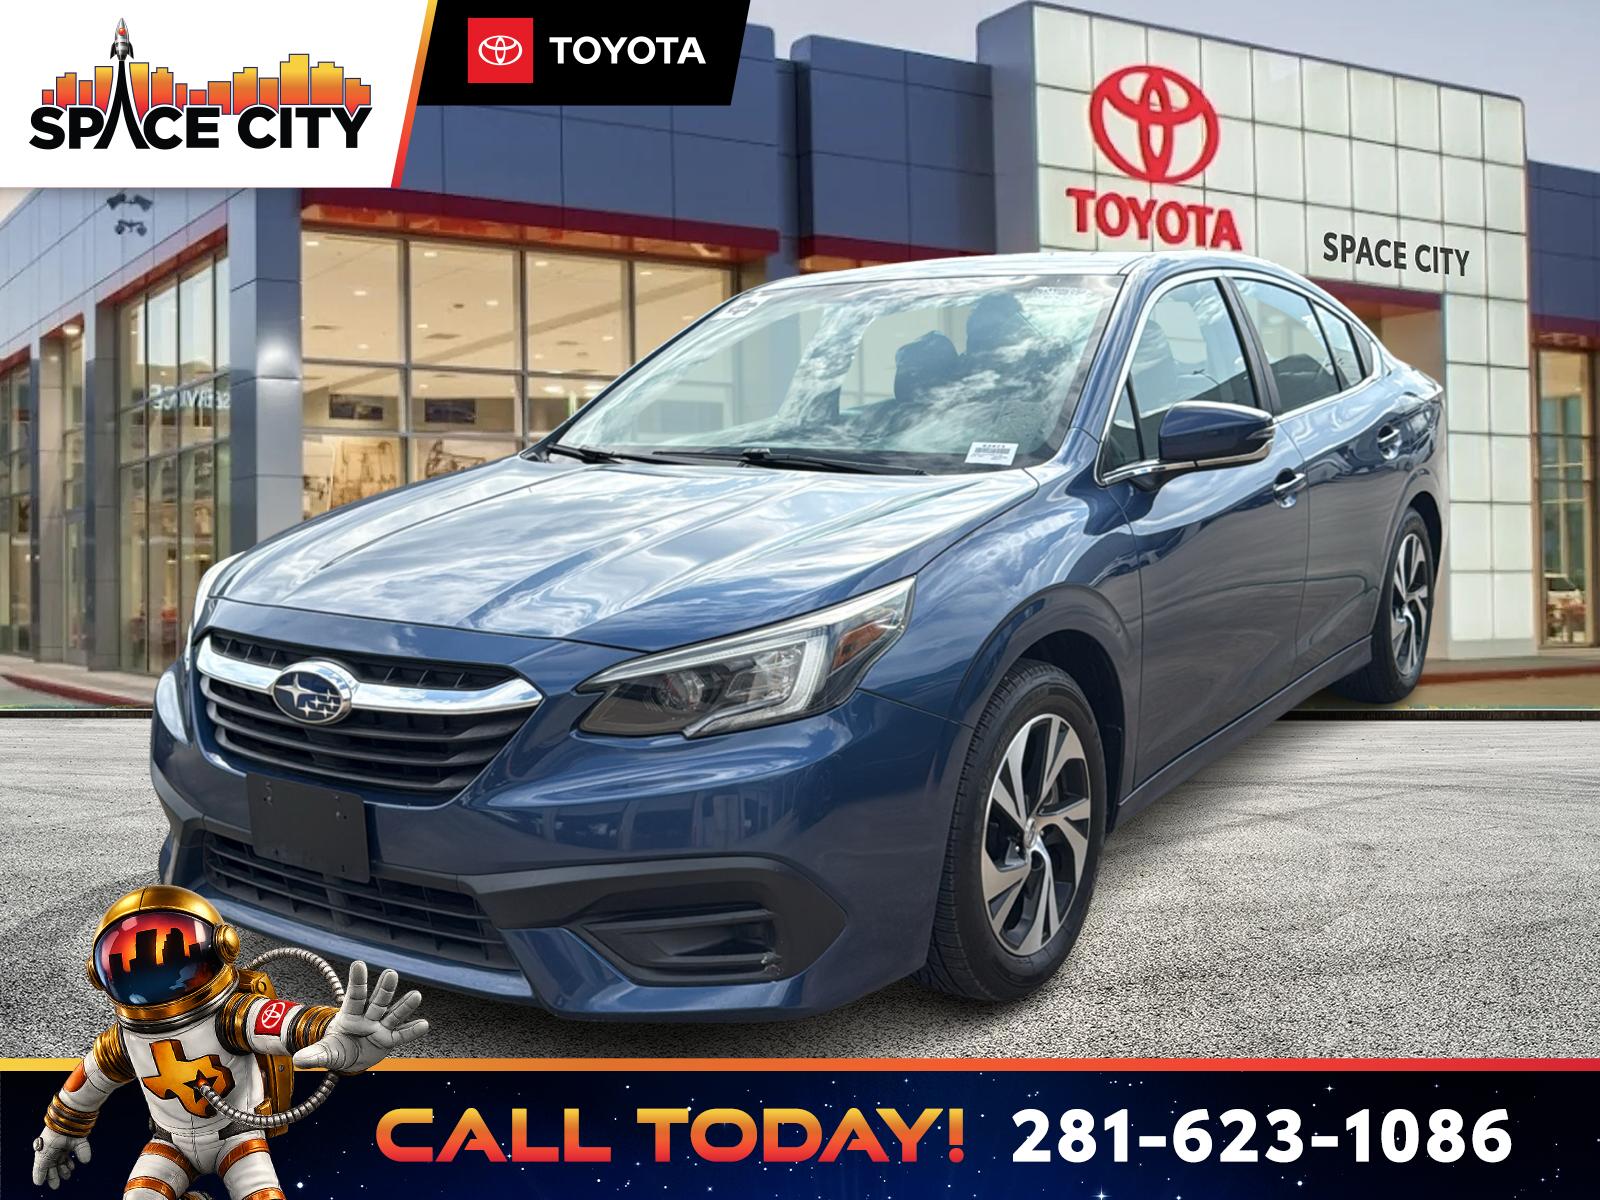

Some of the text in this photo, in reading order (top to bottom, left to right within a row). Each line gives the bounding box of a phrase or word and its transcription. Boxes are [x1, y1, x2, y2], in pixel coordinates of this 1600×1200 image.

[1066, 187, 1243, 251] TOYOTA
[1323, 232, 1470, 277] SPACE CITY
